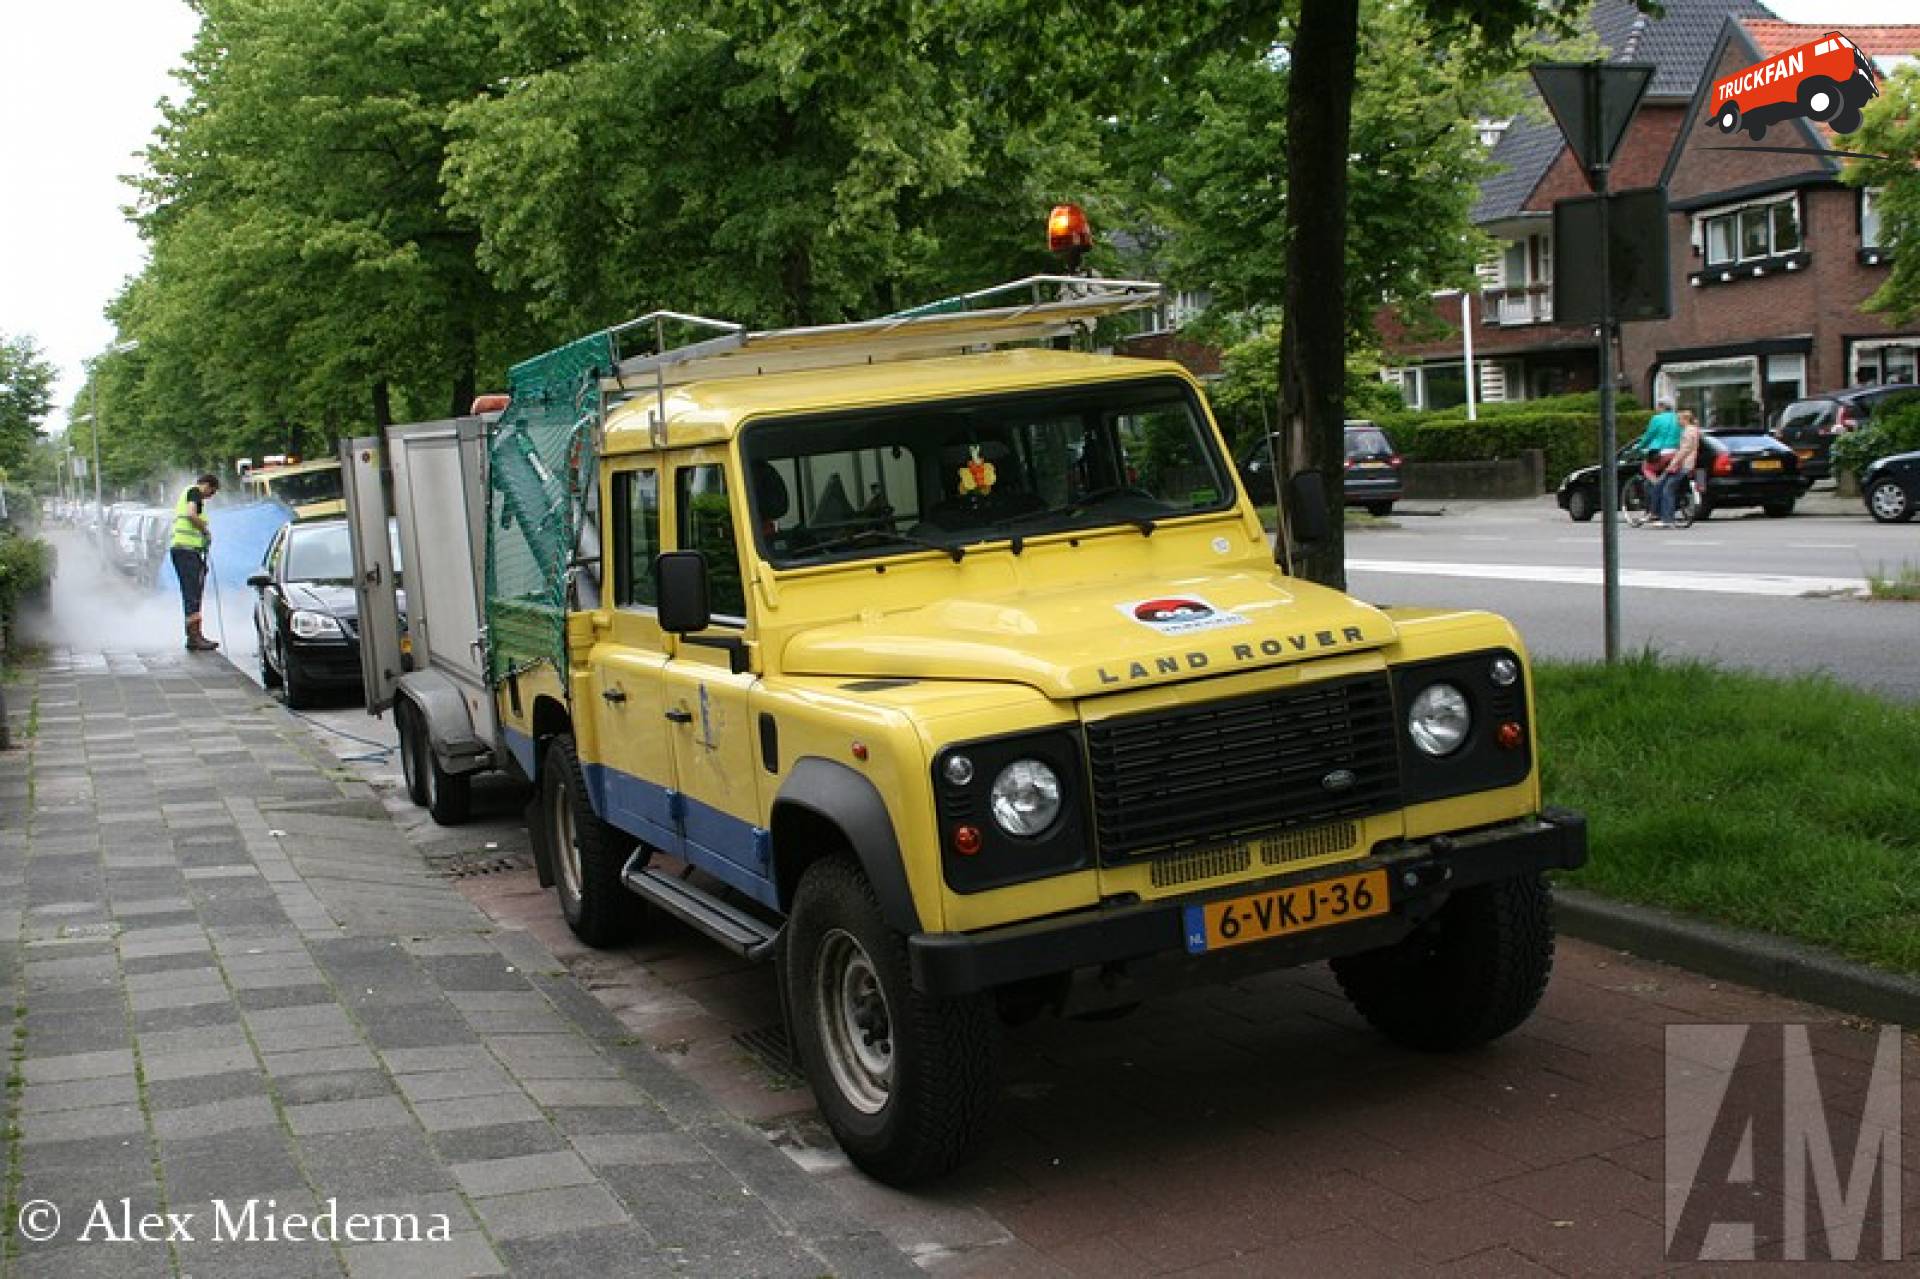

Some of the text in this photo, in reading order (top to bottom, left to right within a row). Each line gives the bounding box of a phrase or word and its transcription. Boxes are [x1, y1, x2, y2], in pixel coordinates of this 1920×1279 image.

[1097, 626, 1365, 685] LAND ROVER
[1219, 878, 1373, 939] 6-VKJ-36
